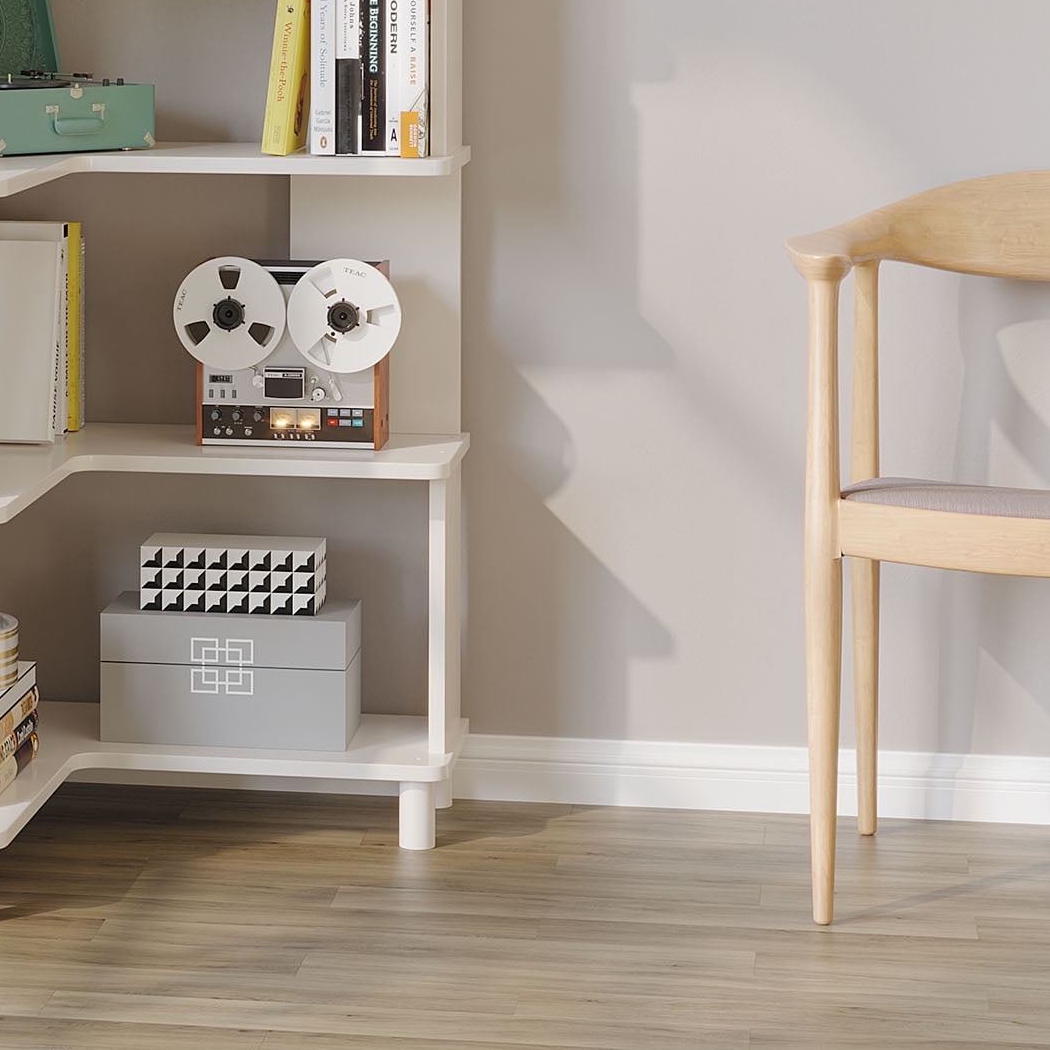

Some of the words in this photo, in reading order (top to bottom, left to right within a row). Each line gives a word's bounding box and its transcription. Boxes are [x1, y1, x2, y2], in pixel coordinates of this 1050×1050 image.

[319, 4, 328, 30] Years
[349, 2, 357, 30] Johns
[319, 33, 328, 45] of
[369, 7, 379, 72] BEGINNING
[319, 48, 328, 88] Solitude
[409, 56, 417, 86] RAISE
[342, 266, 367, 278] TEAC
[176, 288, 188, 312] TEAC
